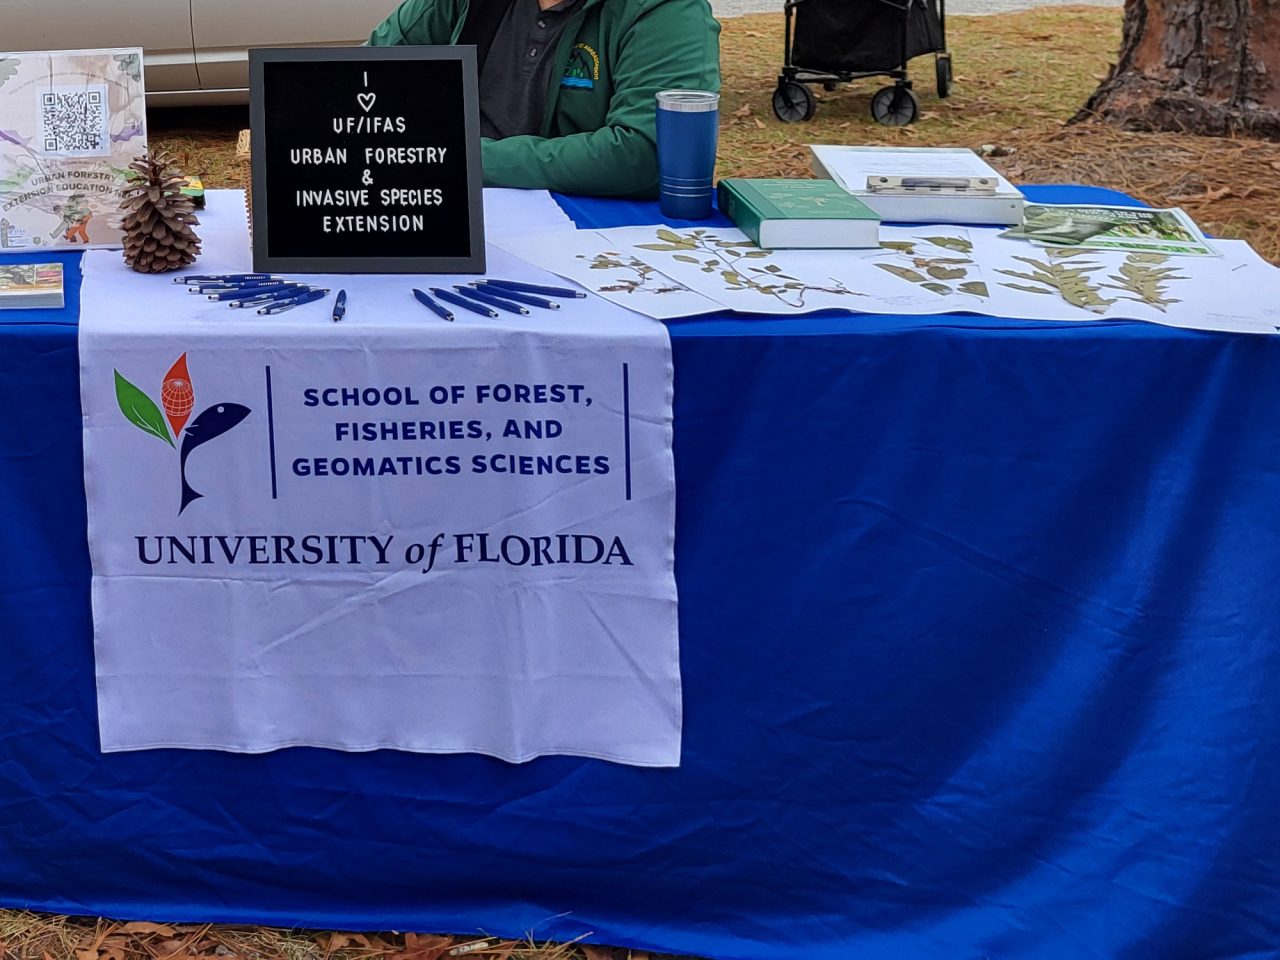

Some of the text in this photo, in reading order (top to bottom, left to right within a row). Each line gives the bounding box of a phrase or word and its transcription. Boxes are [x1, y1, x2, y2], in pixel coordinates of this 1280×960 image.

[332, 116, 406, 134] UF/IFAS
[290, 146, 447, 165] URBAN FORESTRY
[31, 171, 117, 186] URBAN FORESTRY
[361, 169, 374, 185] &
[2, 184, 54, 212] EXTENSION
[56, 182, 113, 195] EDUCATION
[296, 187, 443, 207] INVASIVE SPECIES
[323, 214, 424, 233] EXTENSION
[303, 383, 593, 408] SCHOOL OF FOREST,
[334, 418, 563, 442] FISHERIES, AND
[291, 454, 610, 477] GEOMATICS SCIENCES
[135, 533, 634, 574] UNIVERSITY of FLORIDA
